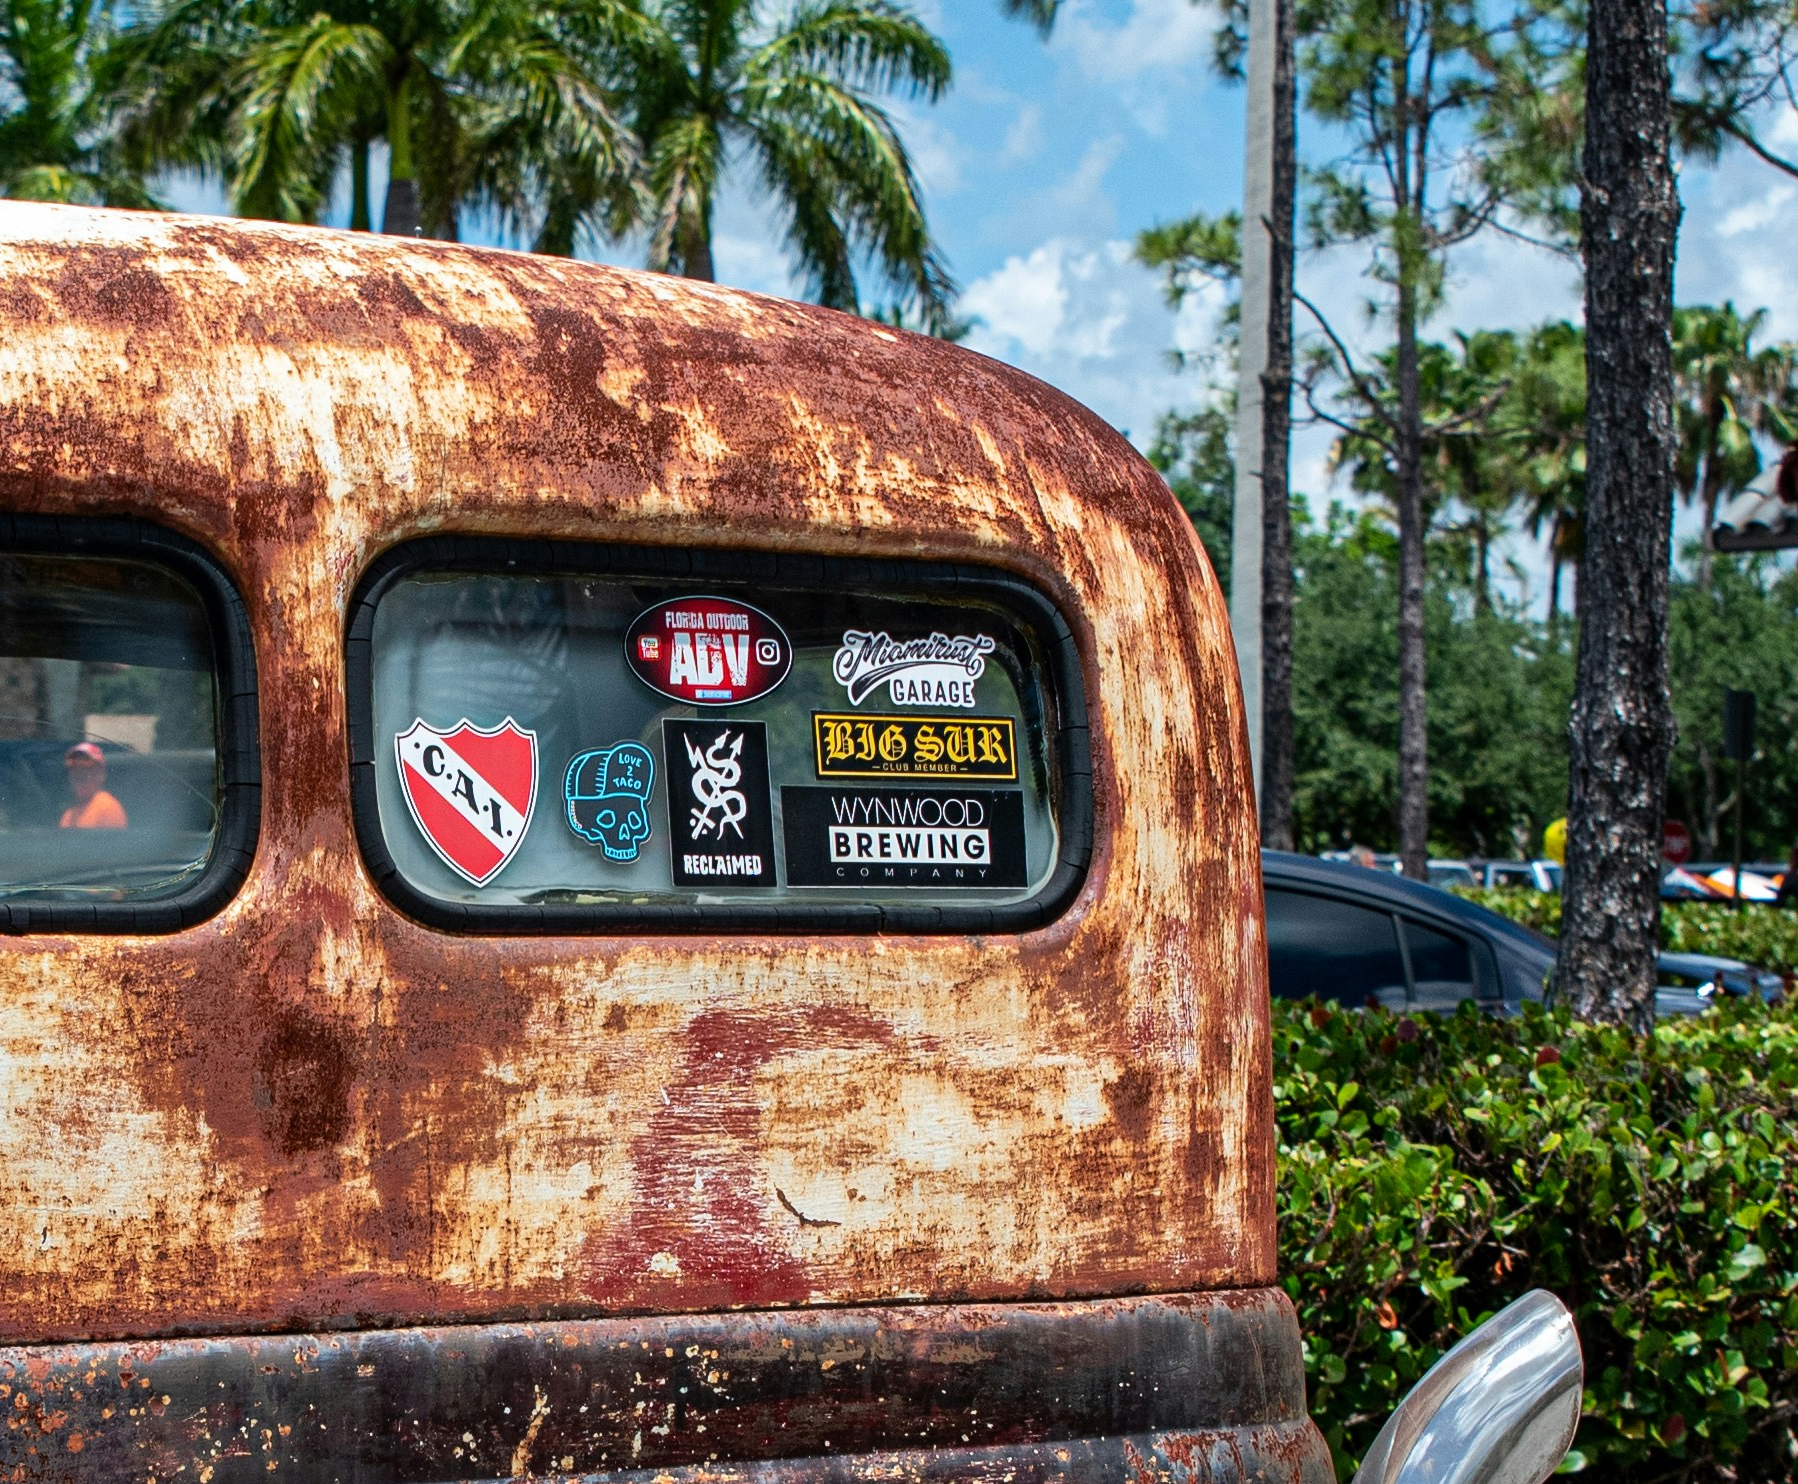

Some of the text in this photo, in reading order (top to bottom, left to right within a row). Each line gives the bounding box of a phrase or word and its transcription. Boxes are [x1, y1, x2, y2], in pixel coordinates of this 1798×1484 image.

[665, 611, 750, 631] FLORIDA OUTDOOR
[669, 632, 751, 686] ADV
[893, 679, 973, 704] GARAGE
[822, 721, 1008, 765] BIG SUR
[618, 752, 642, 767] LOVE
[882, 762, 957, 772] CLUB MEMBER
[626, 765, 634, 777] 2
[612, 776, 642, 790] TACO
[831, 796, 984, 827] WYNWOOD
[834, 832, 986, 860] BREWING
[836, 867, 986, 878] COMPANY
